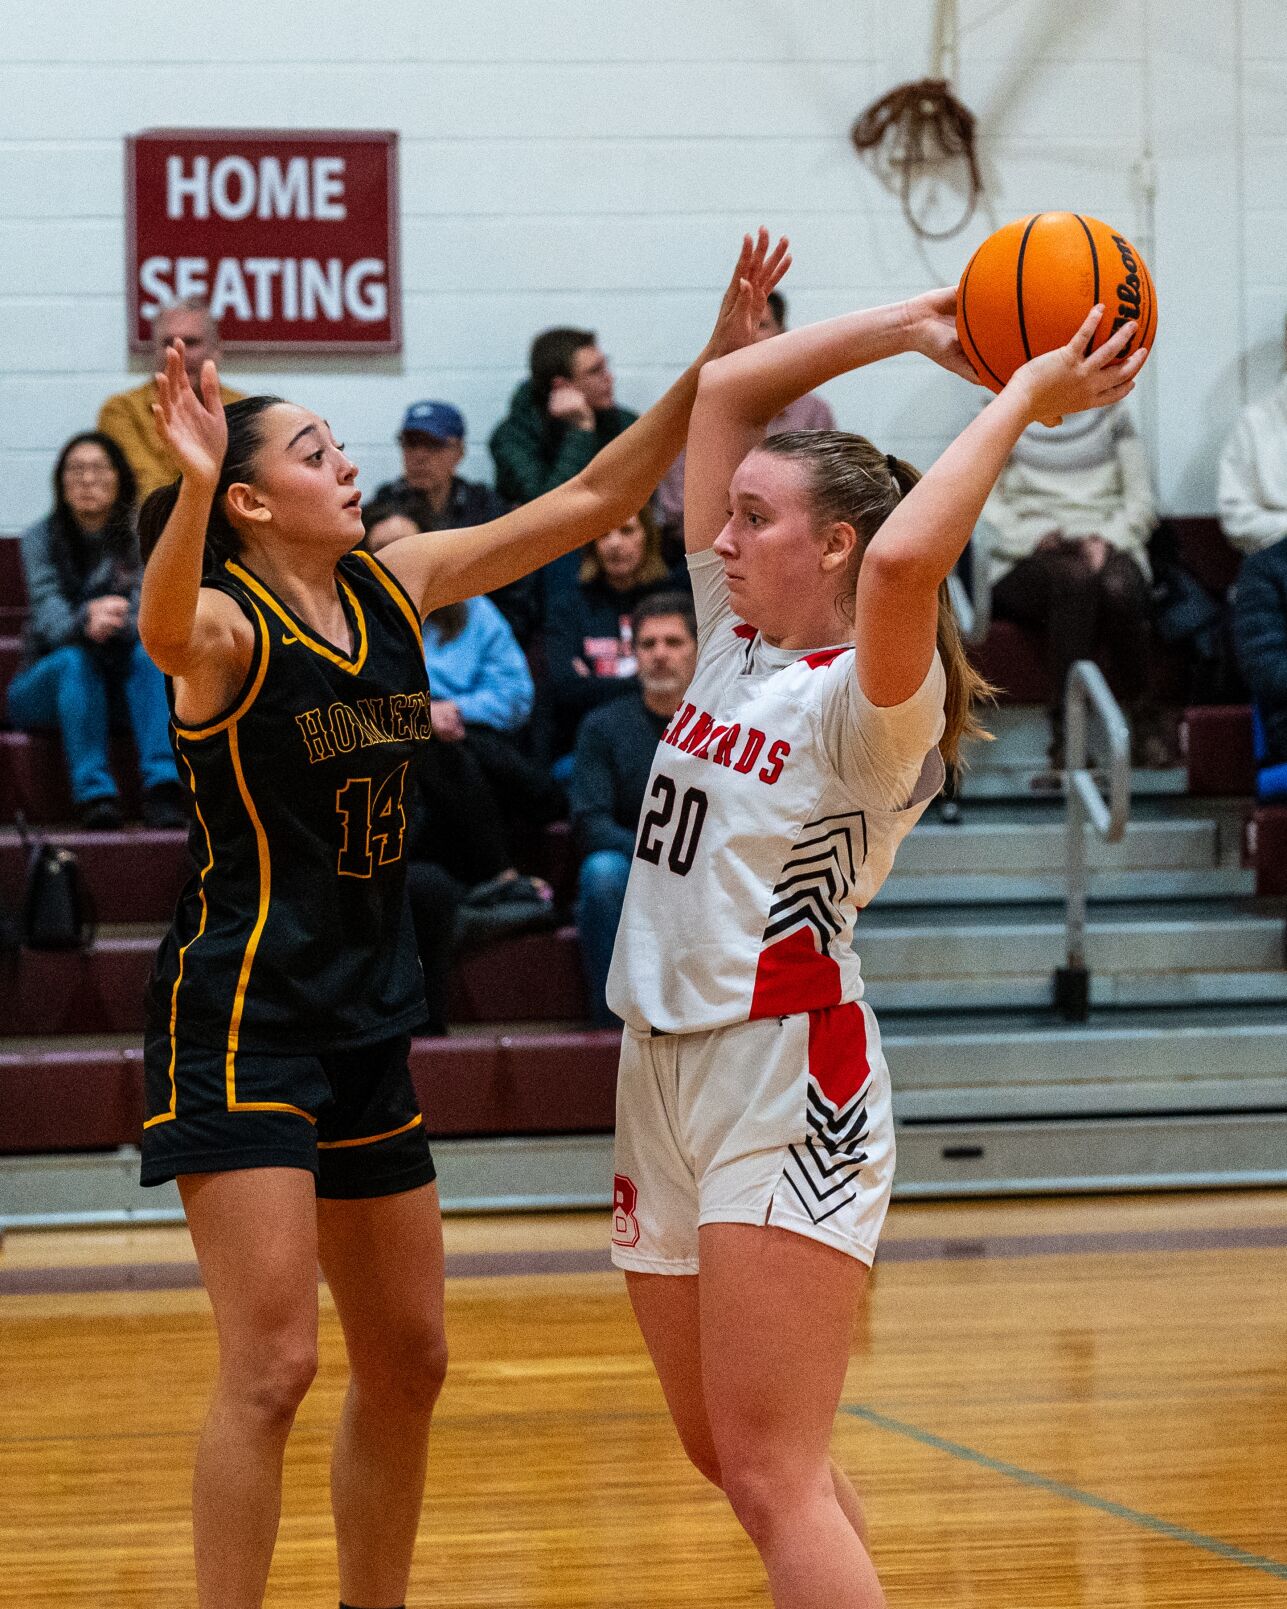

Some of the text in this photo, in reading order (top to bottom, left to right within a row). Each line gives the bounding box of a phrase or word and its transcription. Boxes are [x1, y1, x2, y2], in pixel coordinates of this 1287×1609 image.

[165, 154, 347, 221] HOME
[139, 256, 388, 322] SEATING
[294, 690, 432, 764] HONETS
[336, 760, 409, 879] 14
[636, 773, 709, 877] 20
[612, 1173, 640, 1248] B
